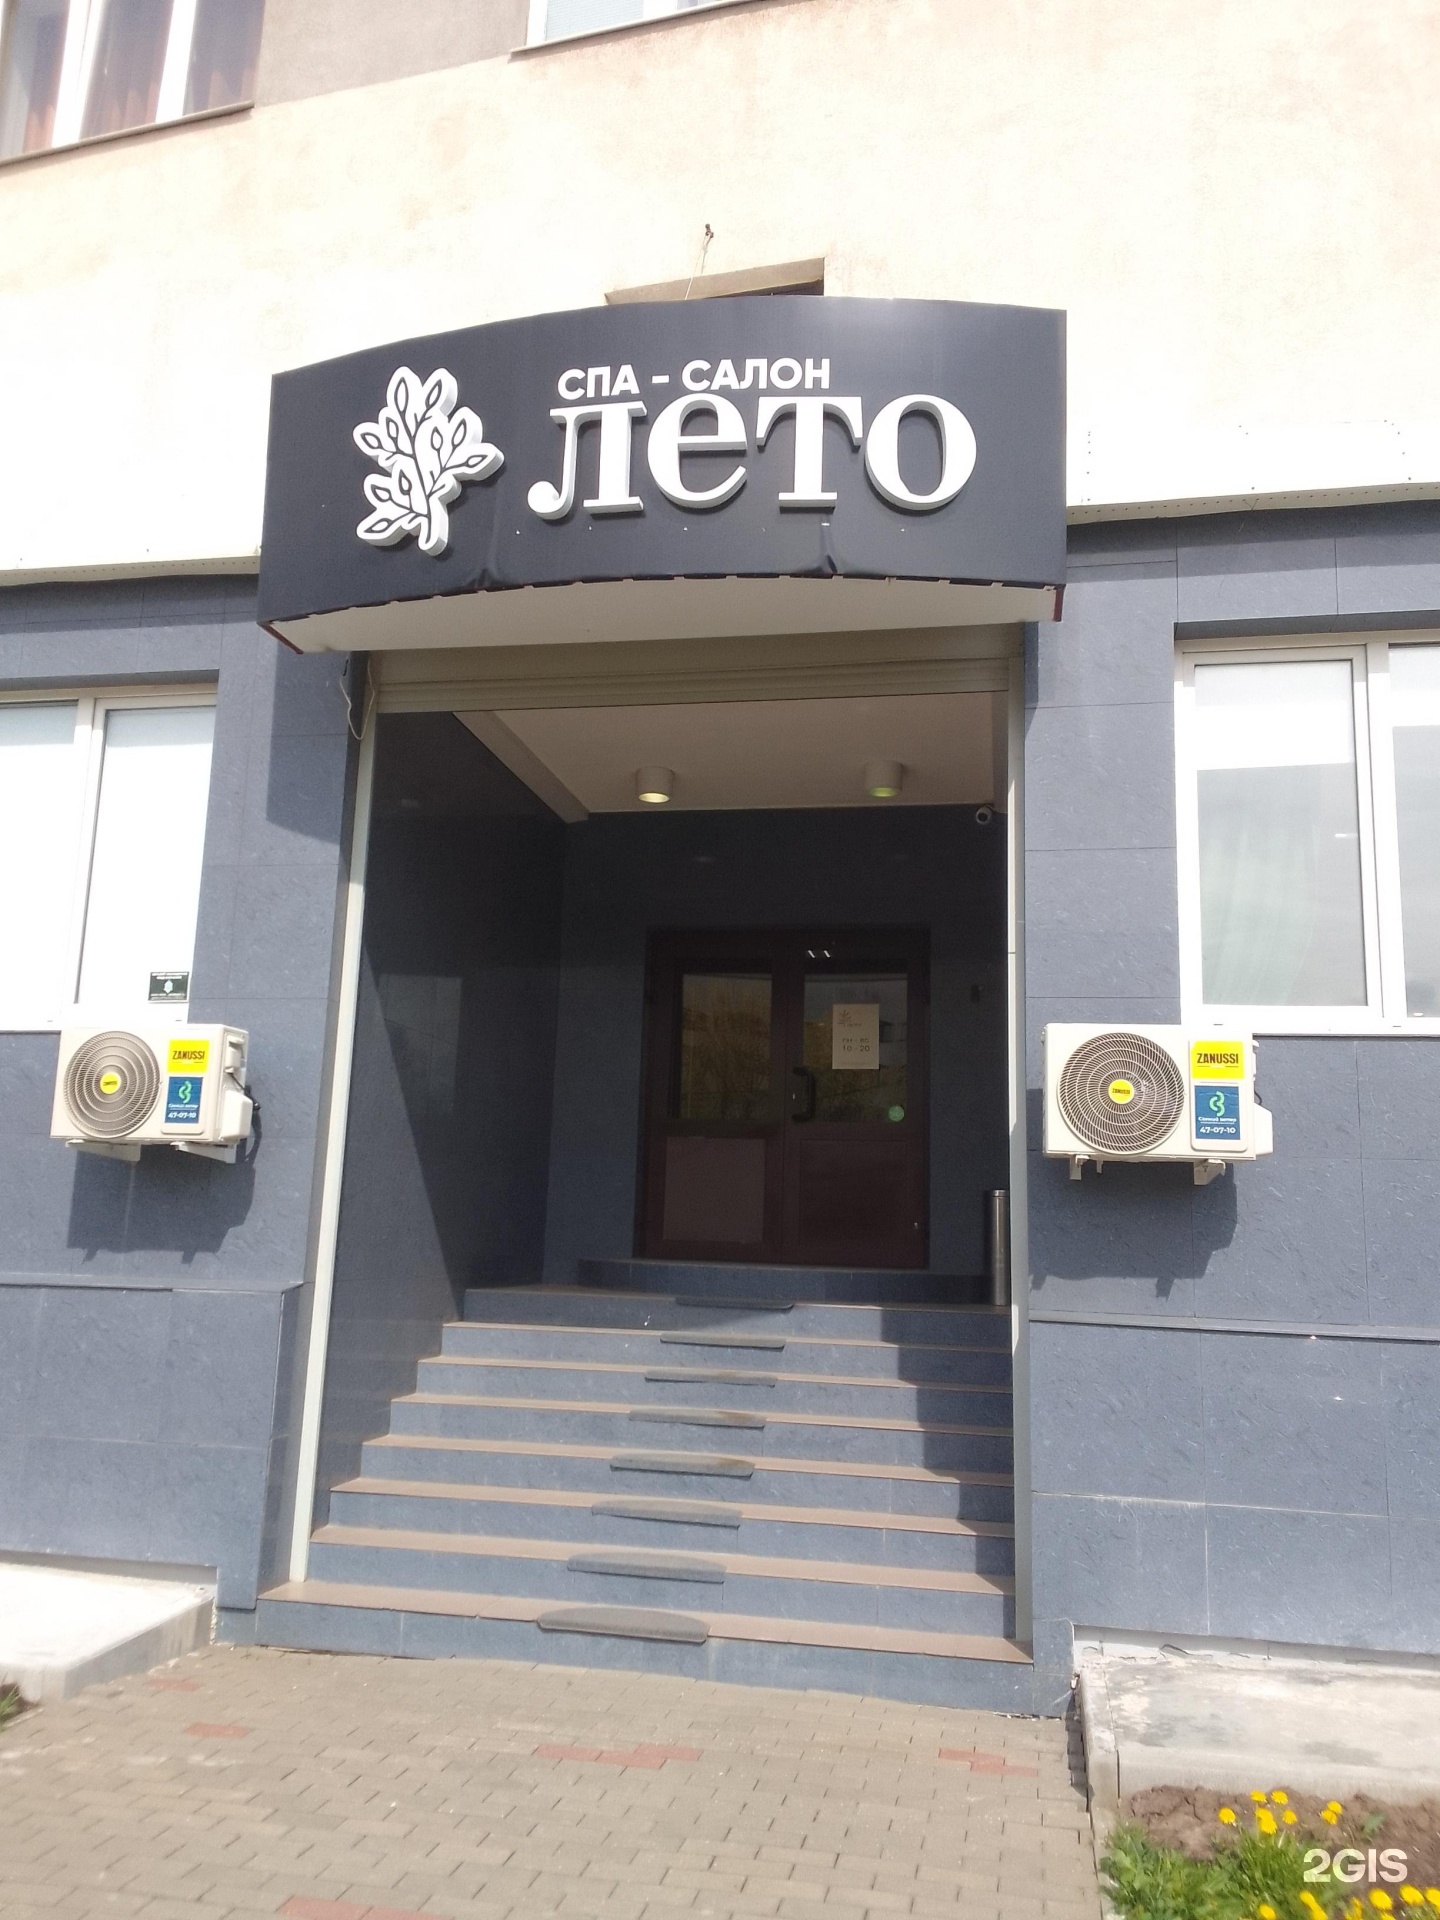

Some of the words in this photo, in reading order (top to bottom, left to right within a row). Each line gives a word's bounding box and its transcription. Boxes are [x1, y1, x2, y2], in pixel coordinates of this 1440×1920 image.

[557, 363, 640, 400] СПА
[681, 357, 830, 391] САЛОН
[172, 1050, 205, 1060] ZANUSSI
[1196, 1053, 1239, 1064] ZANUSSI
[167, 1111, 197, 1119] 47-07-10
[1199, 1126, 1236, 1134] 47-07-10
